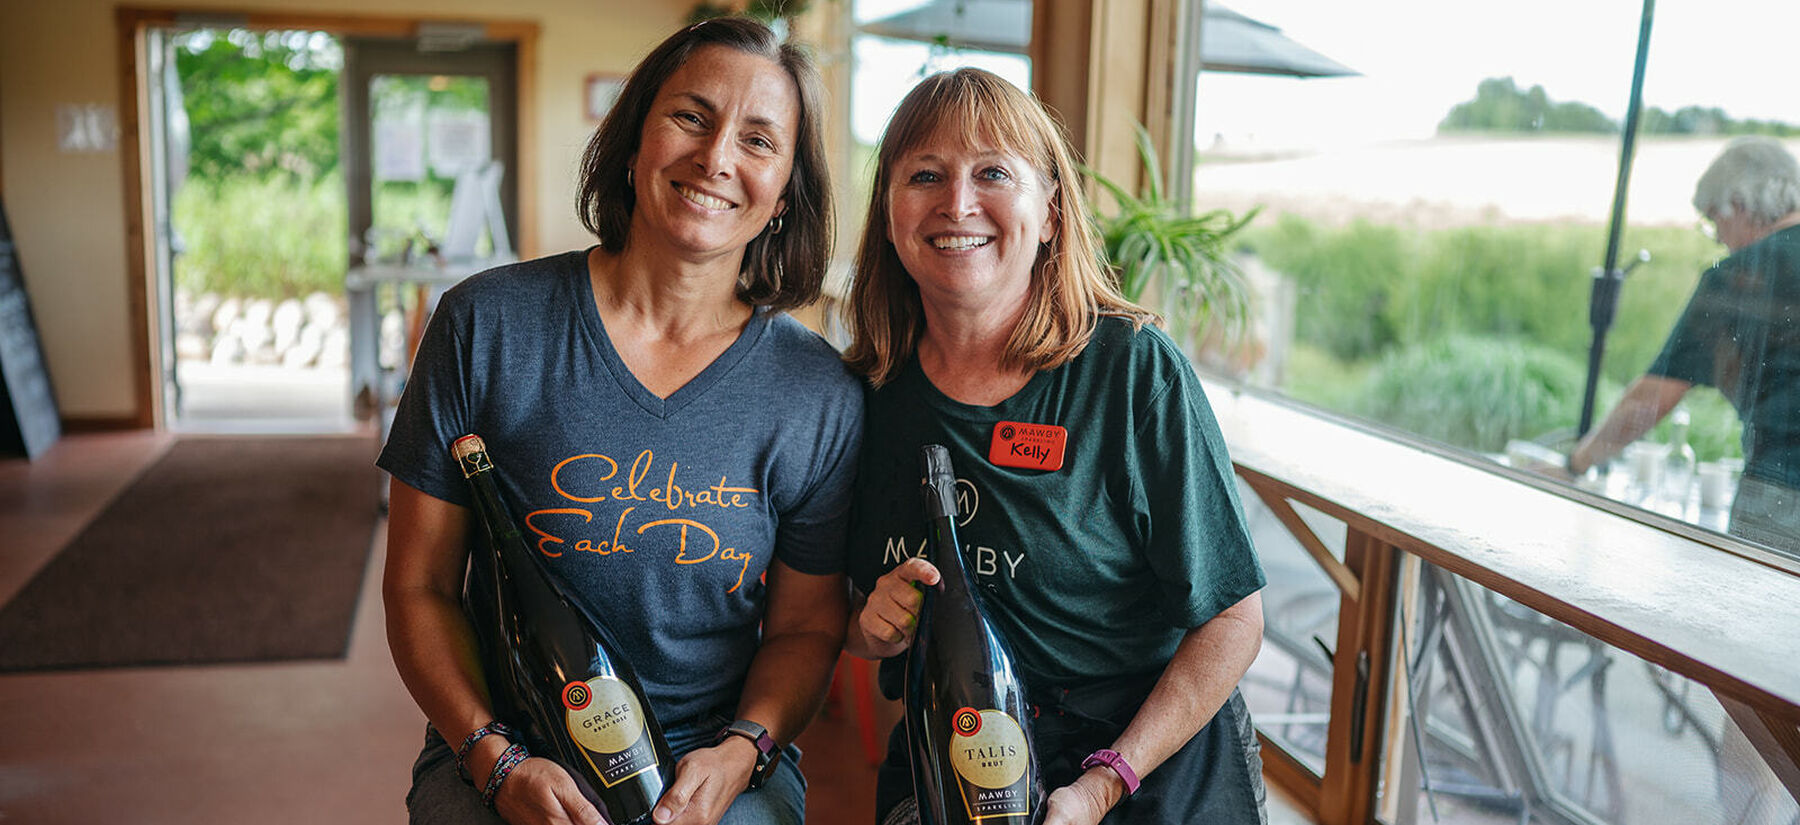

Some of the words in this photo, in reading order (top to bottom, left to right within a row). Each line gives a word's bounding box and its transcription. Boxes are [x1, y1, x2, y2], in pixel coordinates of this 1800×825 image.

[1018, 428, 1060, 438] MAWBY
[1010, 442, 1051, 465] Kelly
[551, 449, 759, 510] Celebrate
[525, 507, 635, 557] Each
[637, 518, 753, 593] Day
[883, 536, 1025, 578] MBY
[582, 703, 630, 729] GRACE
[608, 745, 647, 767] MAWBY
[964, 745, 1018, 761] TALIS
[981, 760, 1004, 768] BRUT
[978, 790, 1019, 801] MAWBY
